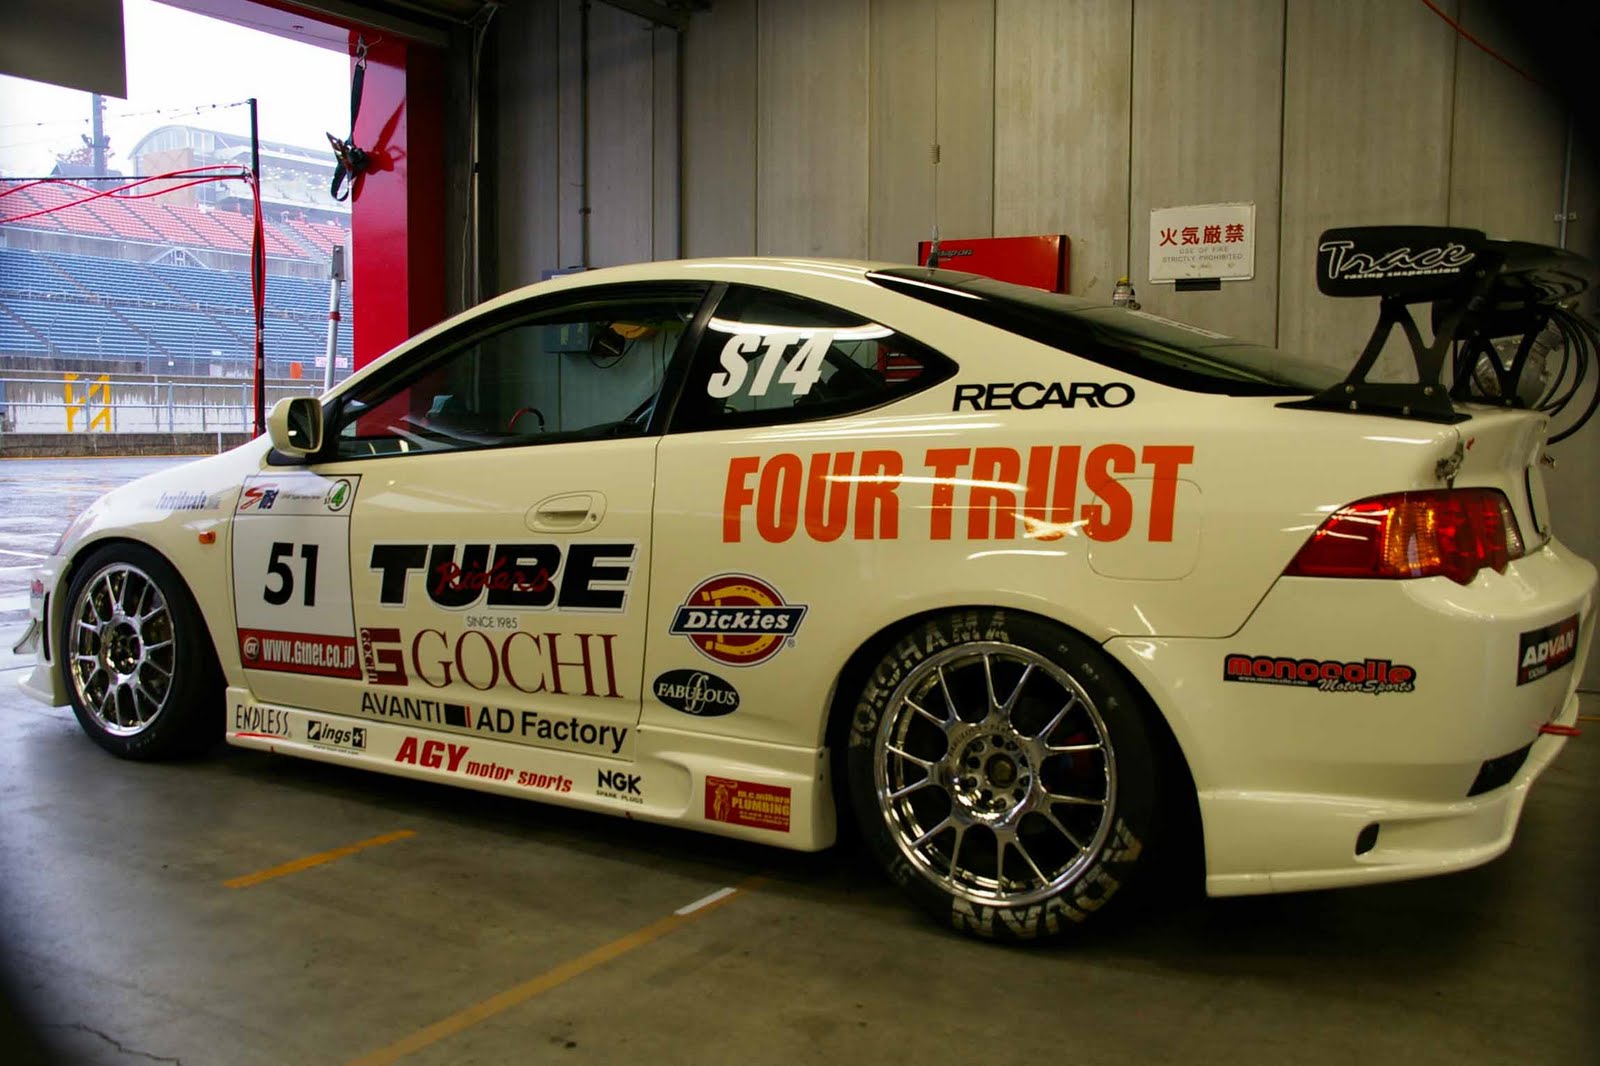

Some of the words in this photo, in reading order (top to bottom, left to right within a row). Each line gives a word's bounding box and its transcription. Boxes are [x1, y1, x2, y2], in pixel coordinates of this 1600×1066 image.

[1159, 223, 1245, 247] 火気厳禁
[1179, 247, 1194, 255] USE
[1212, 245, 1229, 253] FIRE
[1162, 255, 1197, 263] STRICTLY
[1199, 253, 1243, 261] PROHIBITED
[706, 332, 836, 399] ST4
[952, 380, 1136, 412] RECARO
[722, 449, 904, 543] FOUR
[924, 443, 1194, 543] TRUST
[262, 541, 319, 607] 51
[369, 542, 637, 611] TUBE
[434, 556, 550, 596] Riders
[466, 615, 495, 628] SINCE
[496, 616, 518, 629] 1985
[683, 609, 790, 631] Dickies
[411, 628, 625, 699] GOCHI
[1521, 628, 1575, 668] ADVAN
[1227, 656, 1412, 685] monocolle
[361, 691, 441, 723] AVANTI
[657, 682, 737, 706] FABULOUS
[235, 704, 289, 736] ENDLESS
[476, 707, 515, 734] AD
[522, 711, 628, 754] Factory
[395, 736, 469, 773] AGY
[465, 760, 514, 782] motor
[517, 771, 573, 794] sports
[596, 790, 618, 799] SPARK
[621, 794, 644, 805] PLUGS
[597, 767, 642, 796] NGK
